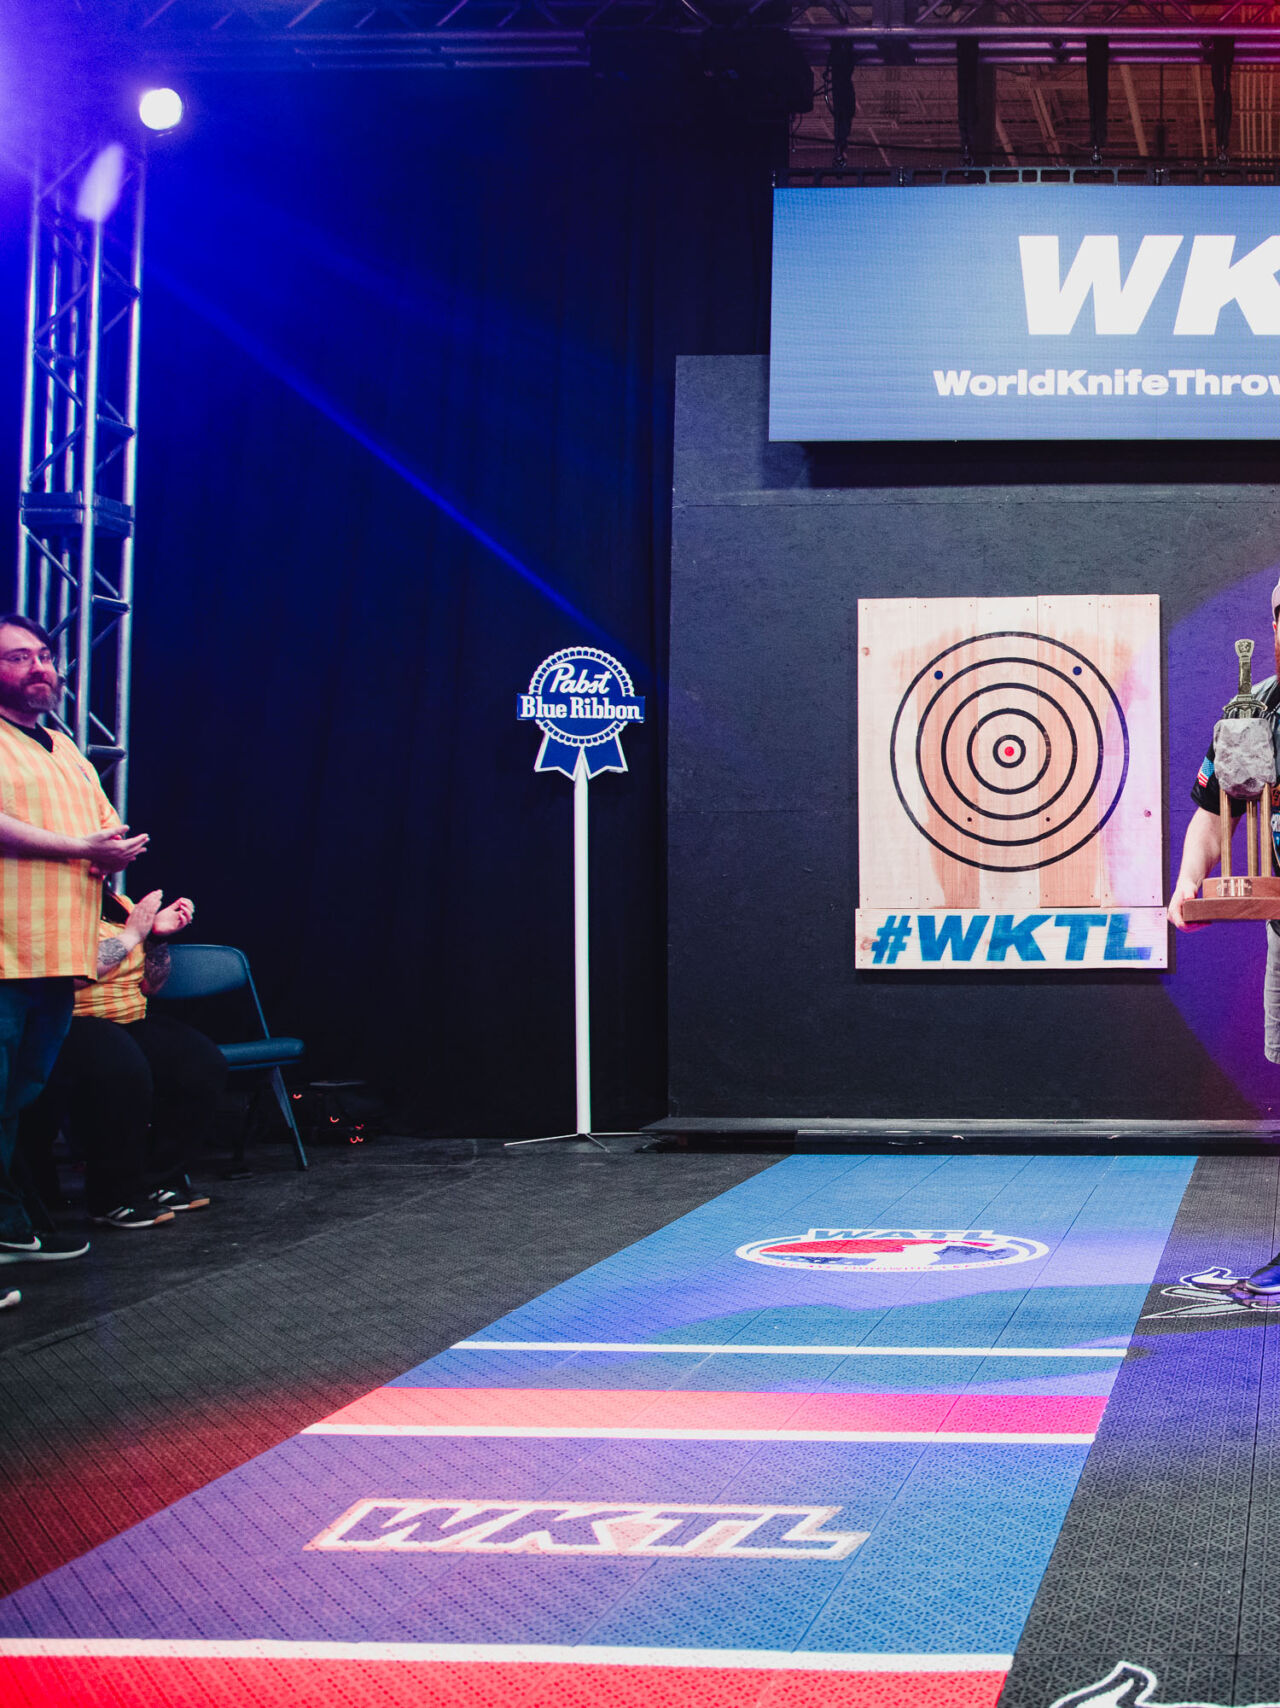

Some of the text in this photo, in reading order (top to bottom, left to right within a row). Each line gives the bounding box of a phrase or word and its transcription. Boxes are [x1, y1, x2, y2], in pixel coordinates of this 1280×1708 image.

[549, 663, 613, 694] Pabst
[520, 695, 644, 720] Blue Ribbon
[871, 913, 1153, 964] #WKTL
[813, 1229, 999, 1242] WATL
[312, 1502, 862, 1556] WKTL
